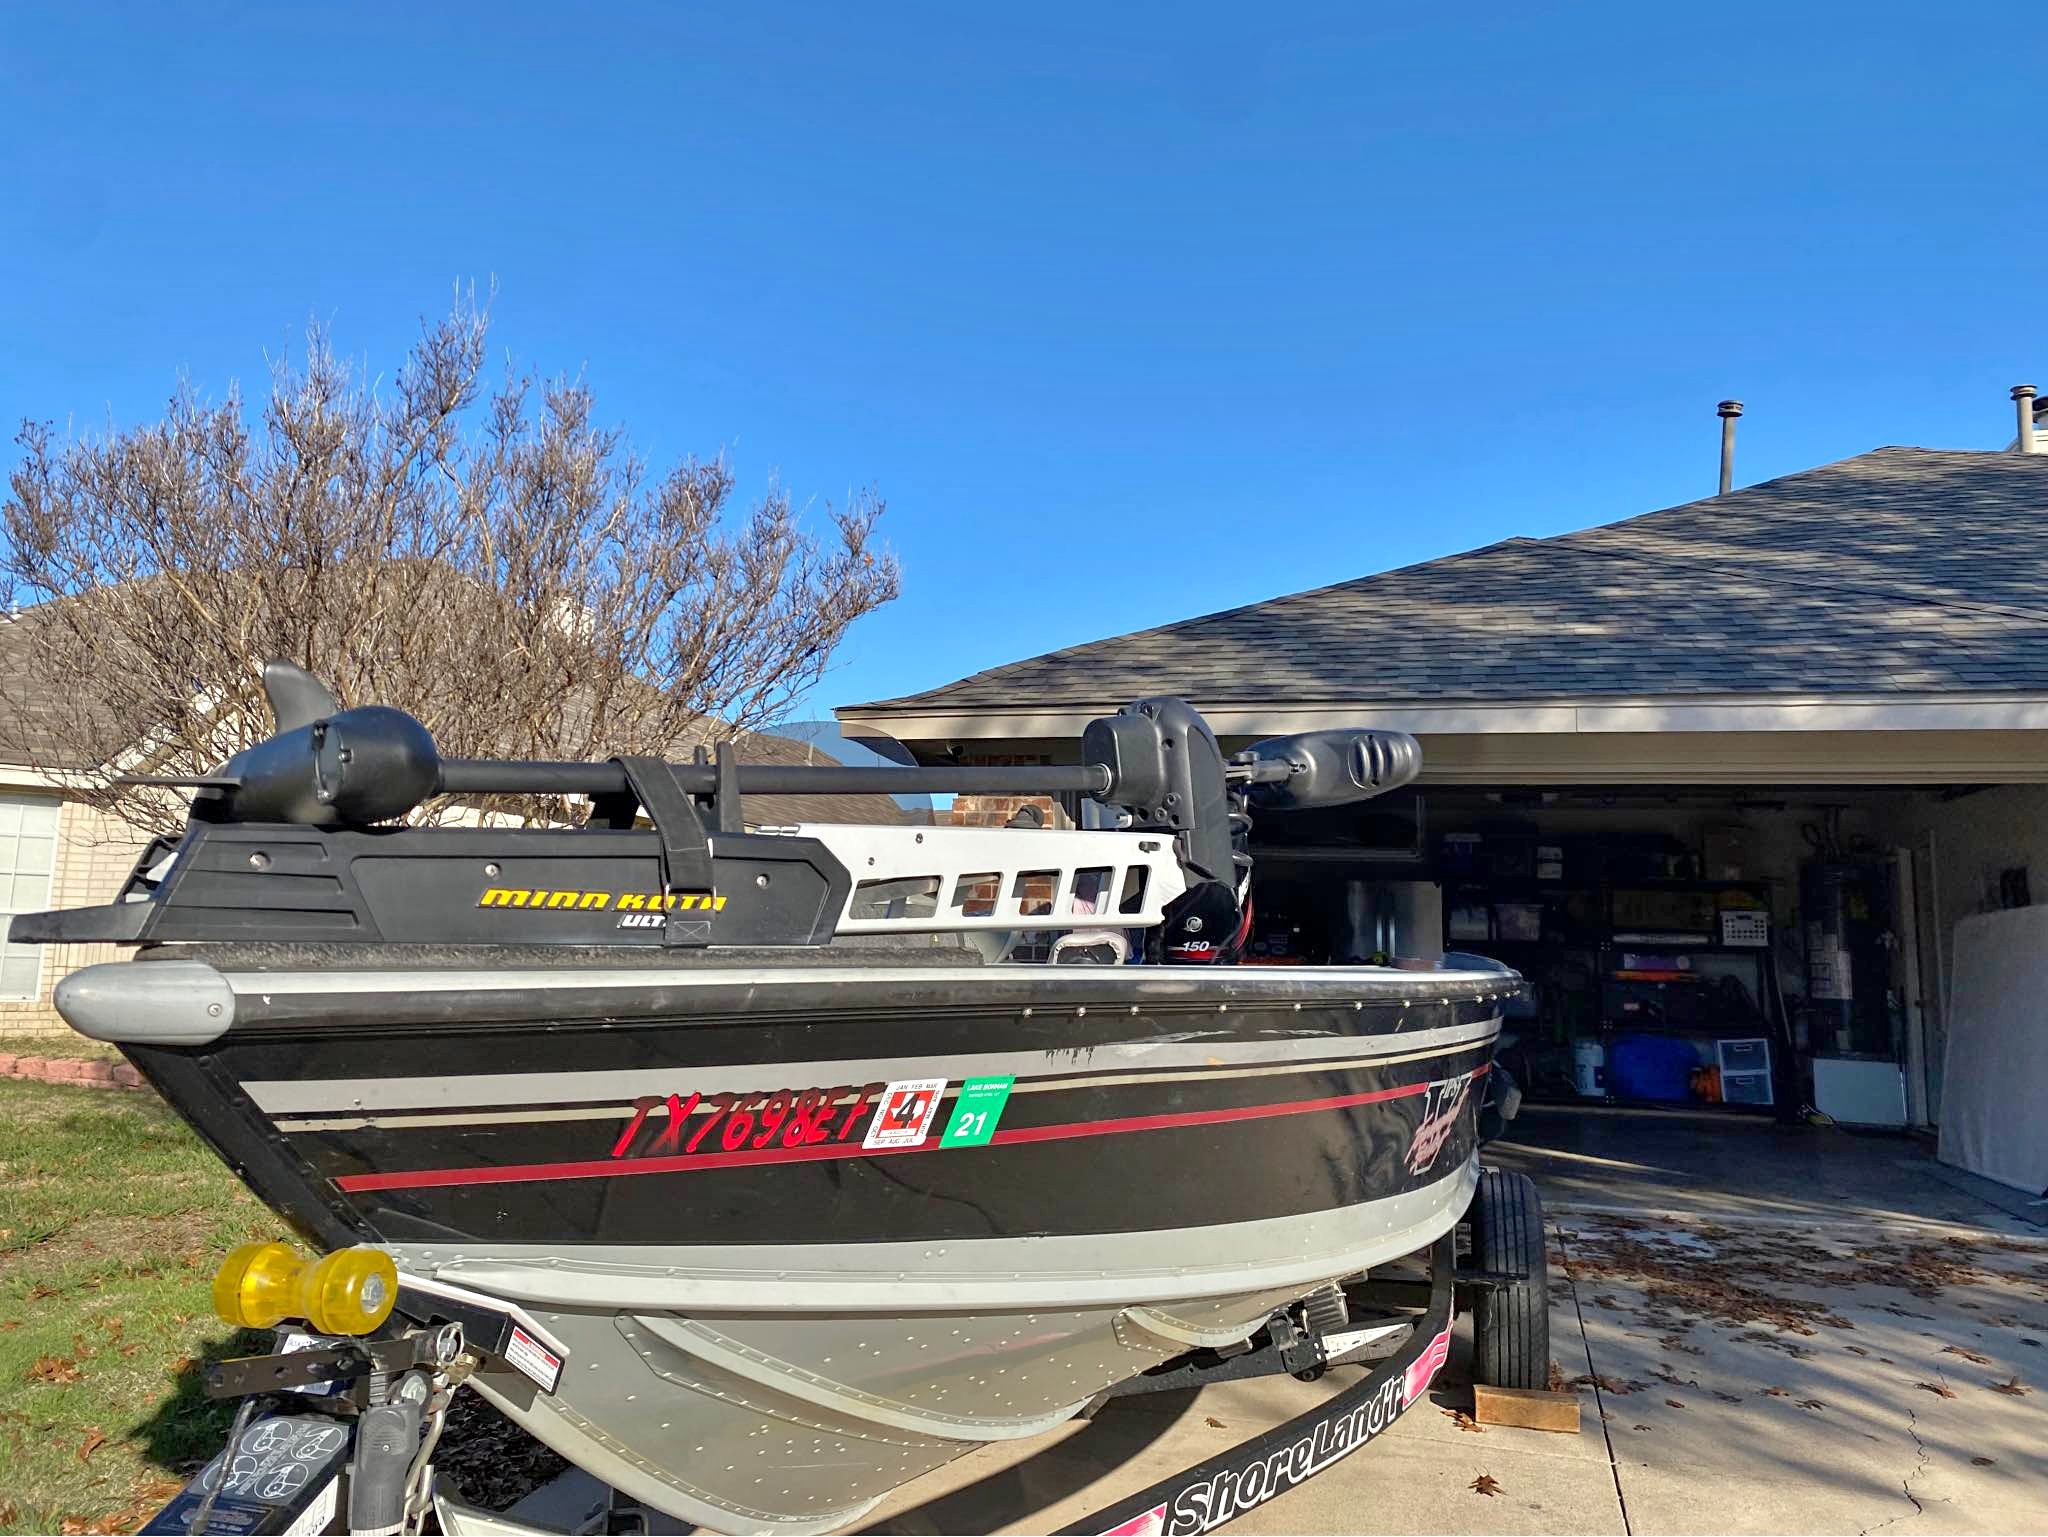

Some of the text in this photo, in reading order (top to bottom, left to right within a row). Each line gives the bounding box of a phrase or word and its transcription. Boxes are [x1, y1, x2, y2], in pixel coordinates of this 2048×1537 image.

[479, 888, 728, 912] MINN KOTA
[621, 914, 667, 928] ULT
[1183, 941, 1210, 952] 150
[967, 1083, 983, 1091] LAKE
[893, 1092, 921, 1130] 4
[953, 1111, 989, 1137] 21
[873, 1138, 886, 1146] SEP
